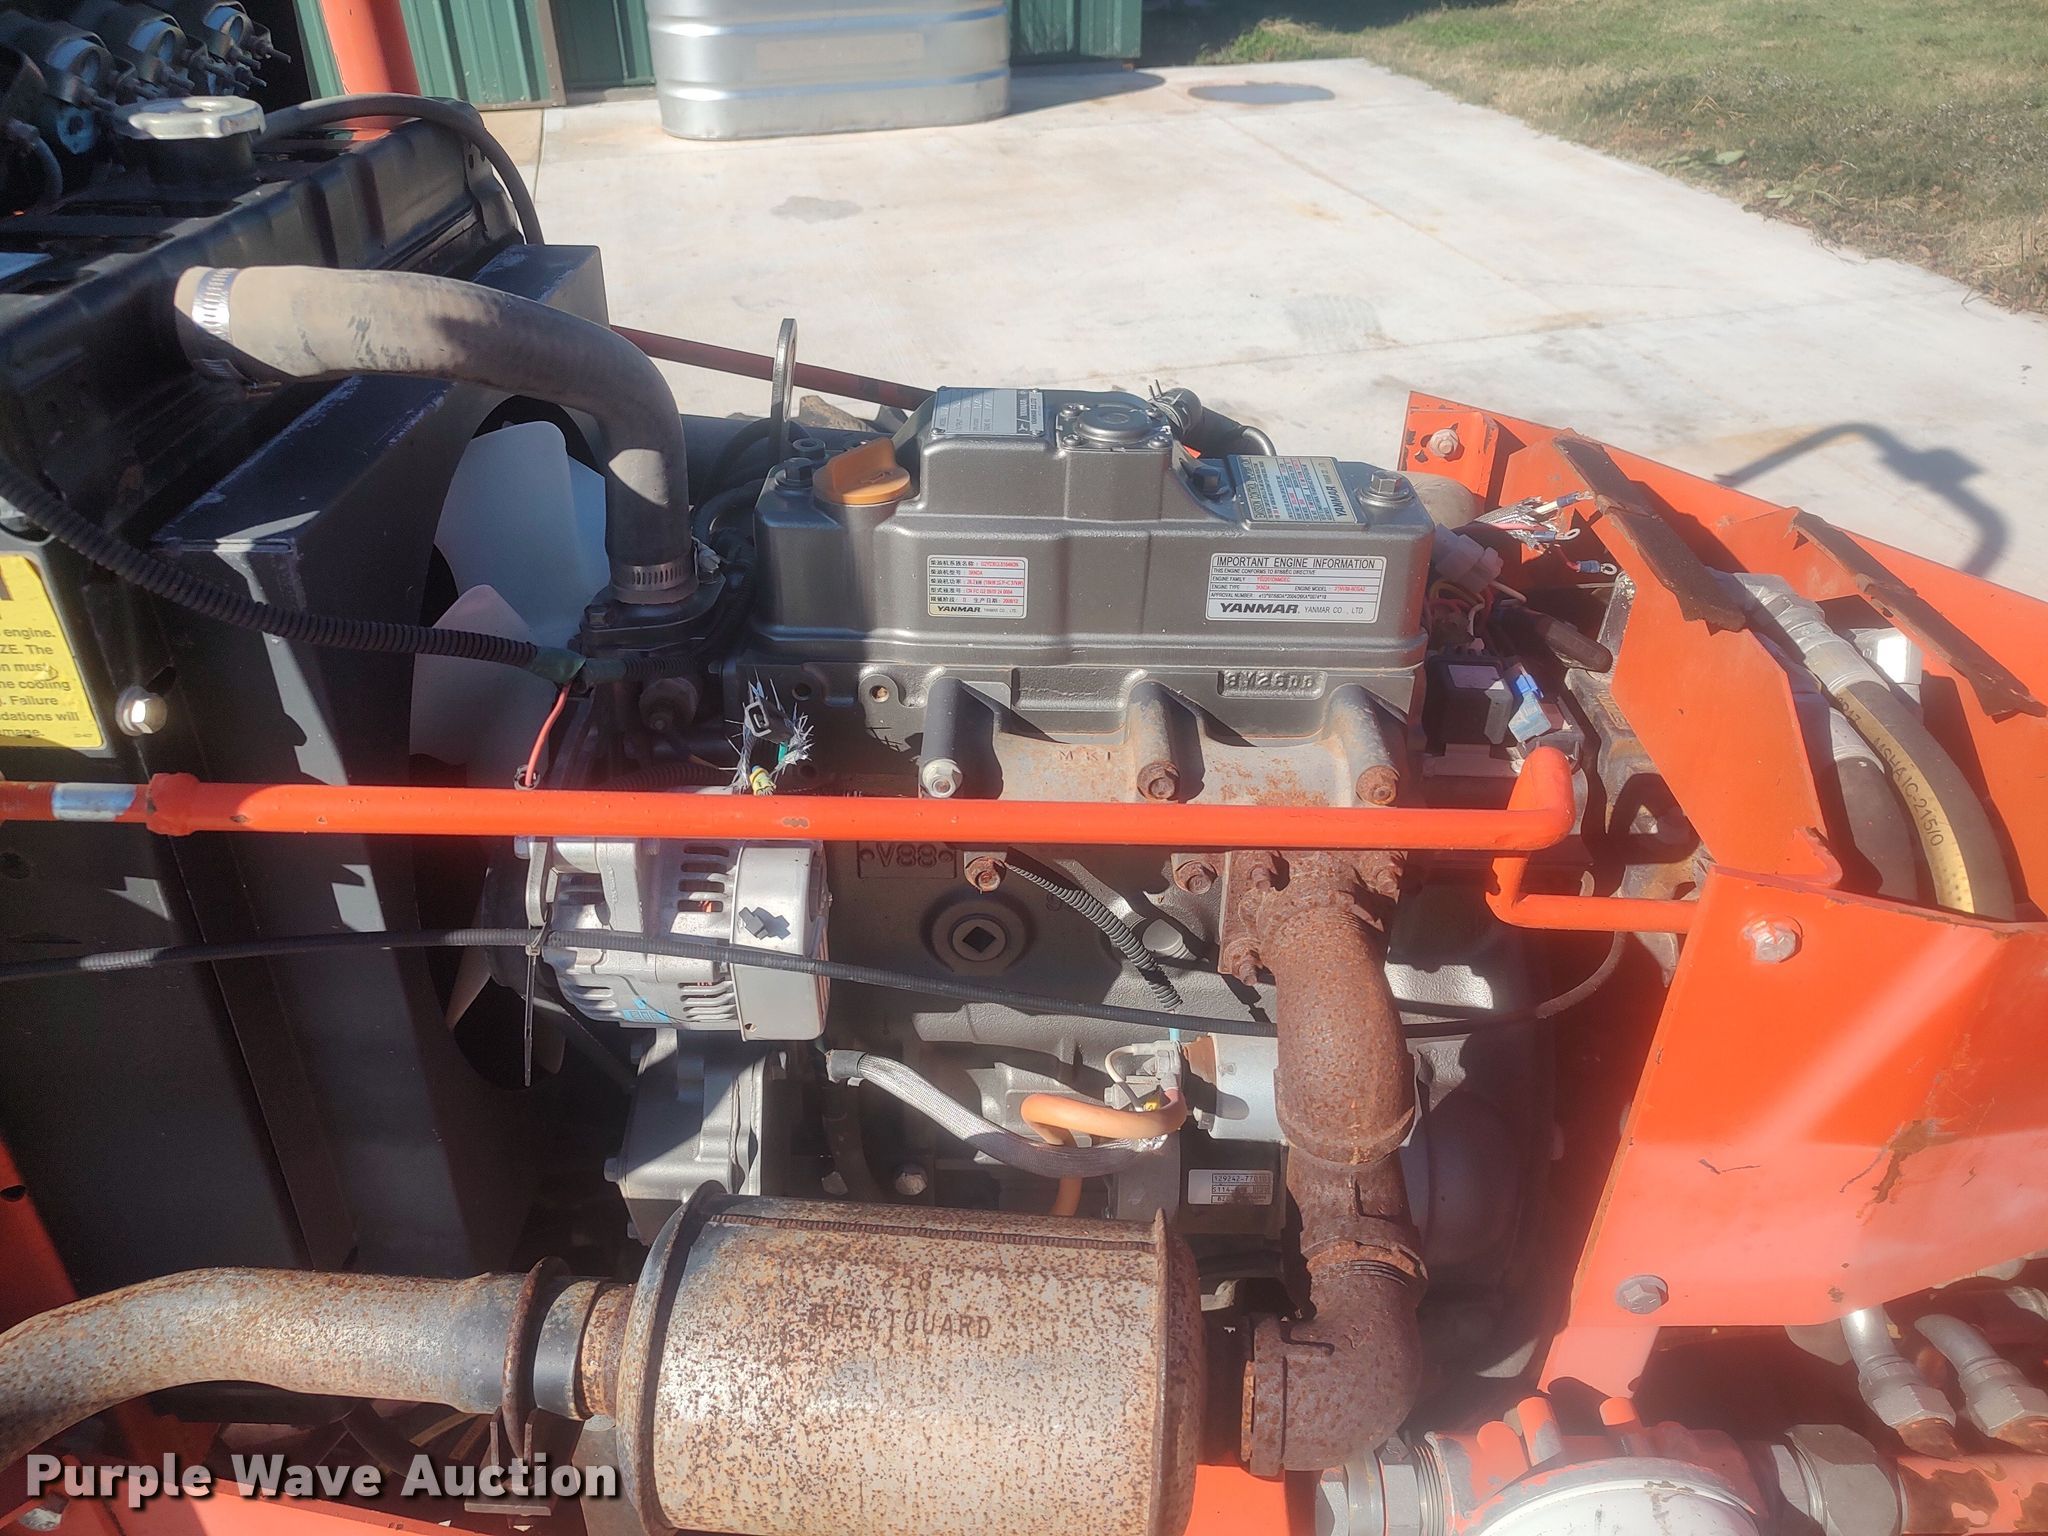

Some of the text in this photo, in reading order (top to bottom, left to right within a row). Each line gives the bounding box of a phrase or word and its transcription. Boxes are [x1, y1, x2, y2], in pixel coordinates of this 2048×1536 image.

[1326, 486, 1347, 517] YANMAR
[1217, 556, 1376, 569] IMPORTANT ENGINE INFORMATION
[1220, 603, 1299, 614] YANMAR
[1305, 606, 1330, 614] YANMAR
[4, 628, 56, 640] engine.
[25, 644, 54, 655] The
[14, 663, 47, 672] must
[19, 680, 71, 692] cooling
[10, 696, 58, 706] Failure
[56, 712, 80, 721] will
